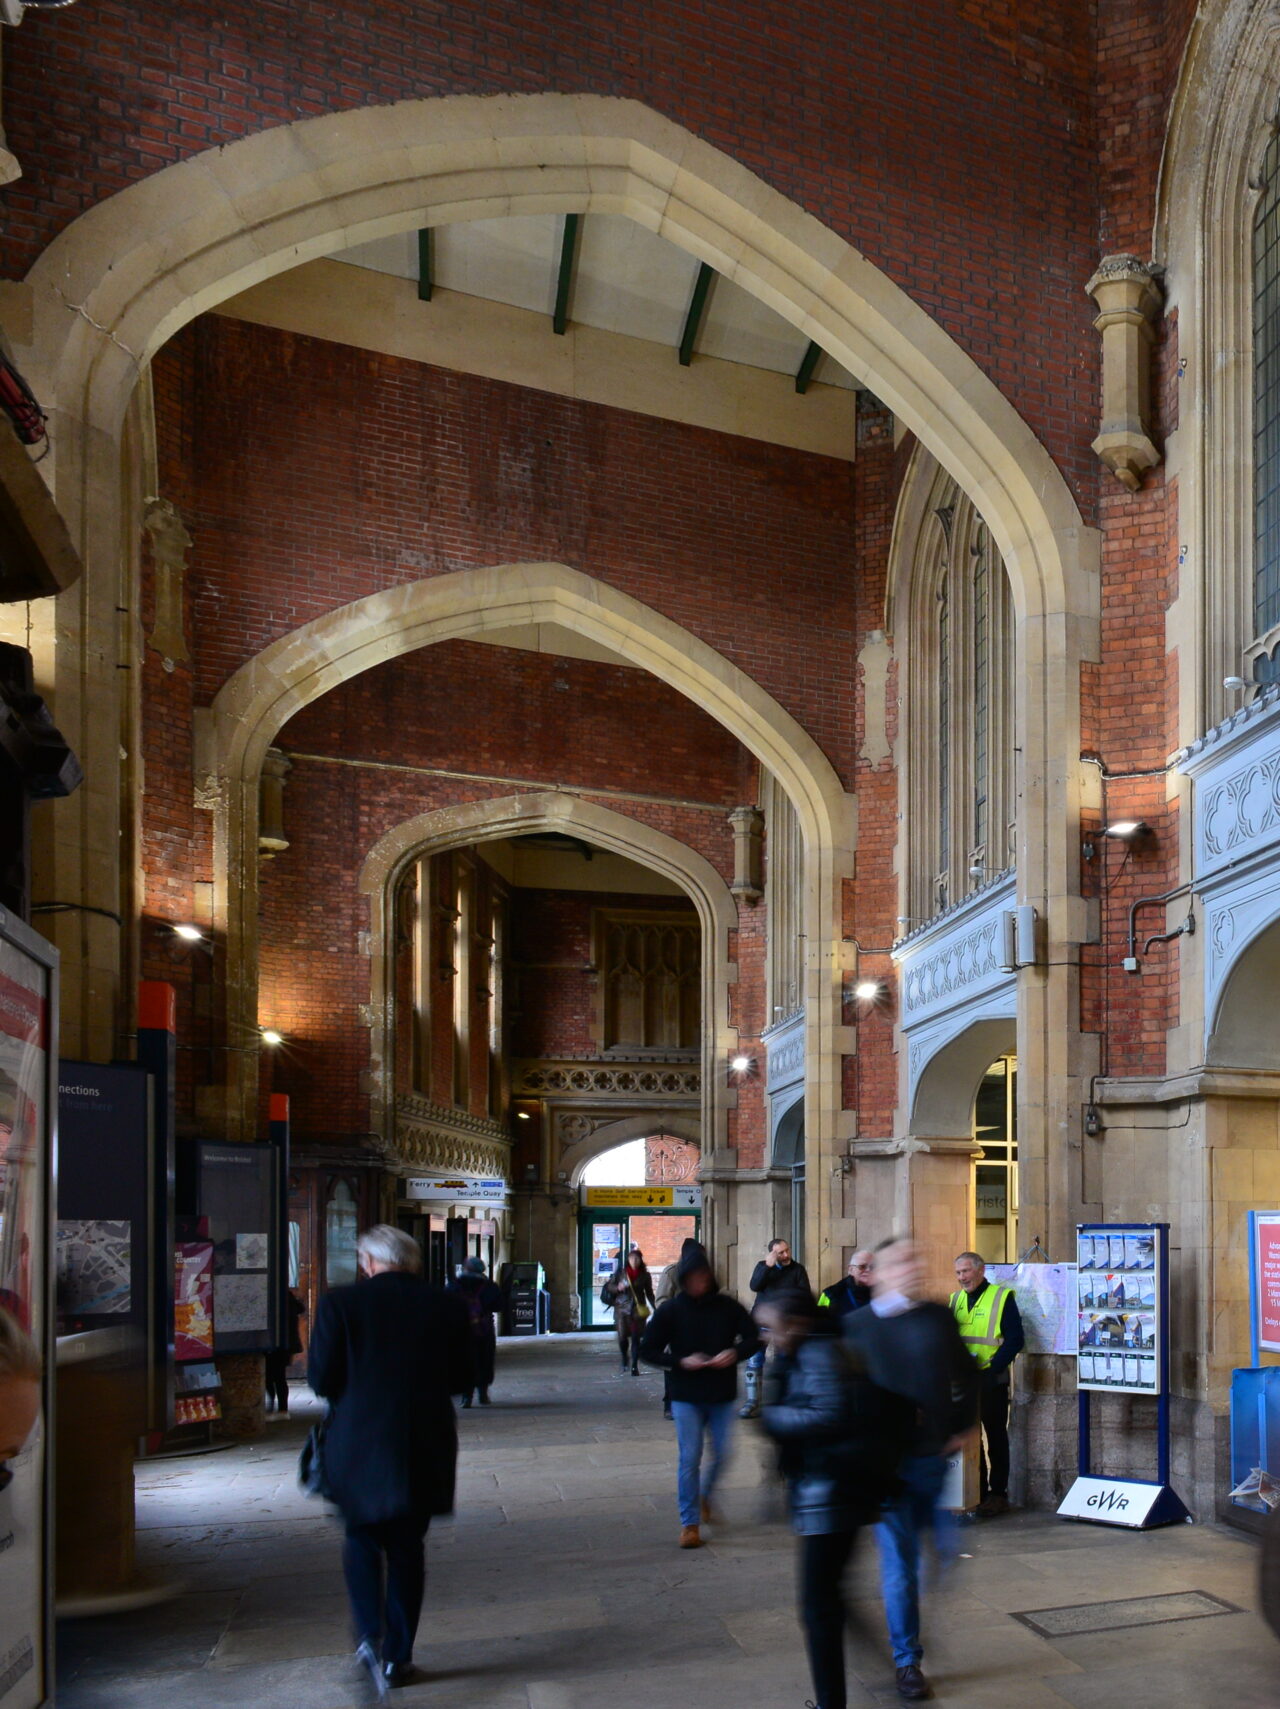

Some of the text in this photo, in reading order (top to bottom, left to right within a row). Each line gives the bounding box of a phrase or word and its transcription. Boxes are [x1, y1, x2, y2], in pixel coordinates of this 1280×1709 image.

[58, 1084, 100, 1096] nections
[976, 1195, 1007, 1209] risto
[1264, 1262, 1276, 1270] major
[1265, 1317, 1278, 1328] Delays
[1087, 1489, 1129, 1511] GWR
